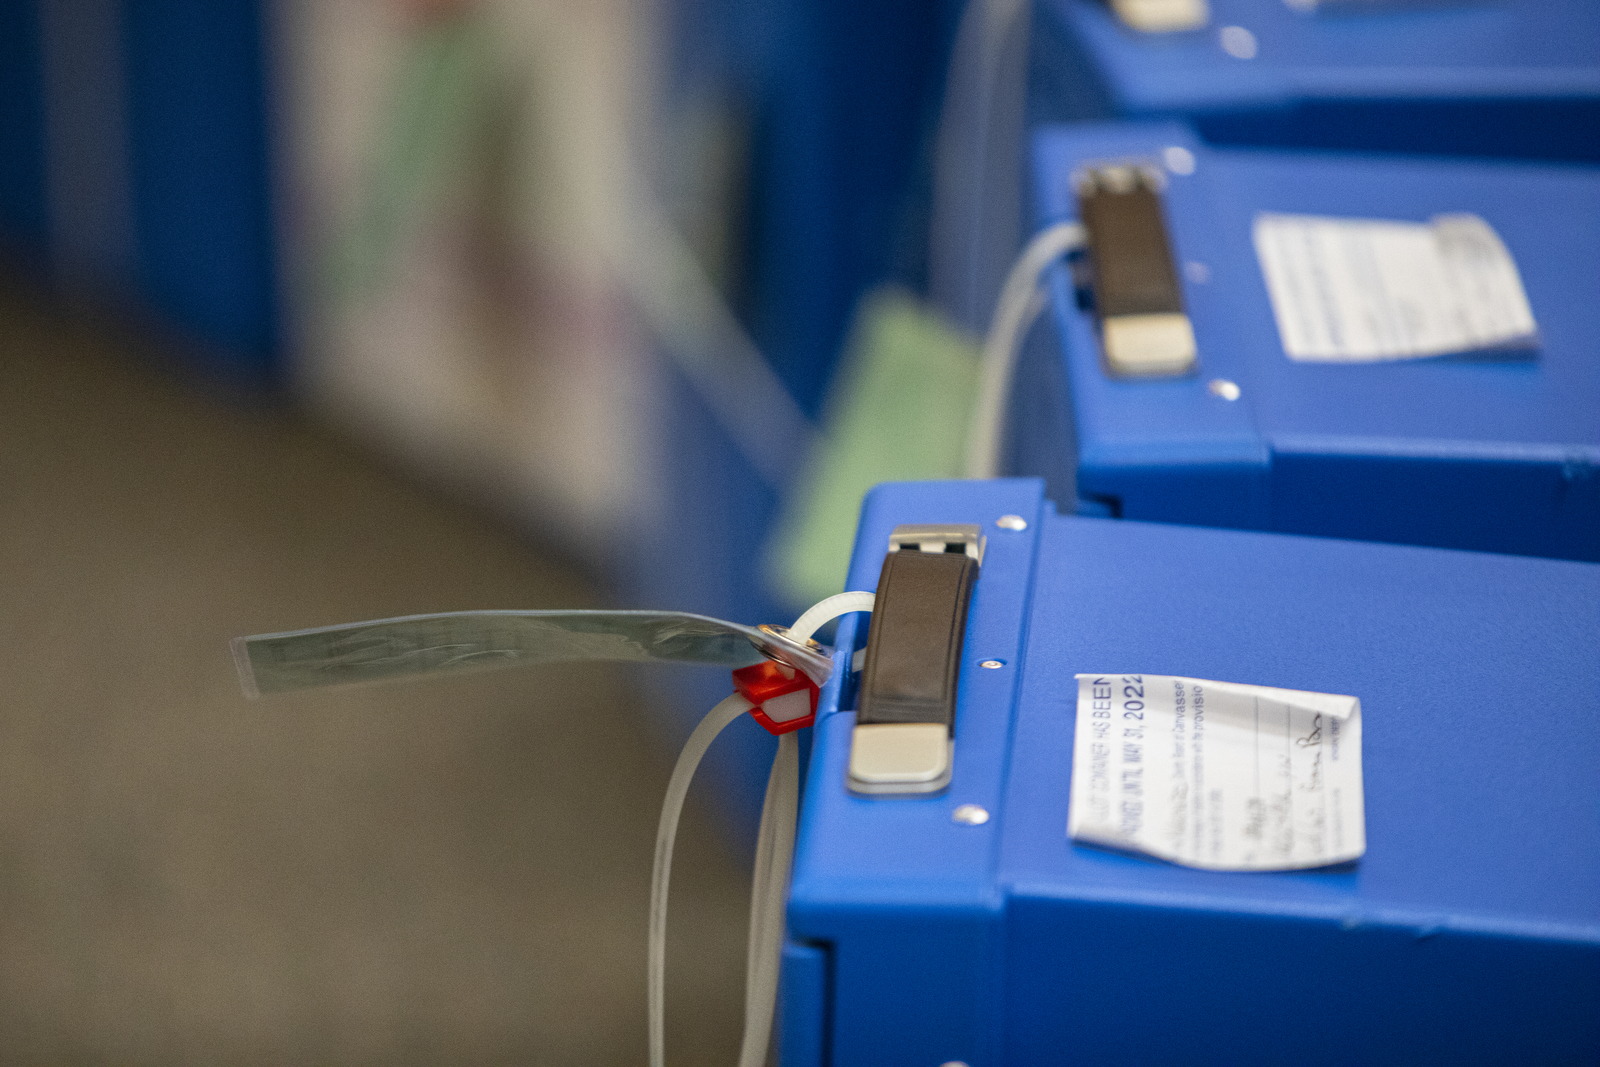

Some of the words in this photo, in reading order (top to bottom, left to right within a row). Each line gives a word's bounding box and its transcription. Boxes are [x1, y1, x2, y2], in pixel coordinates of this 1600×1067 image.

[1122, 675, 1145, 721] 2022
[1092, 721, 1110, 740] HAS
[1122, 741, 1144, 764] MAY
